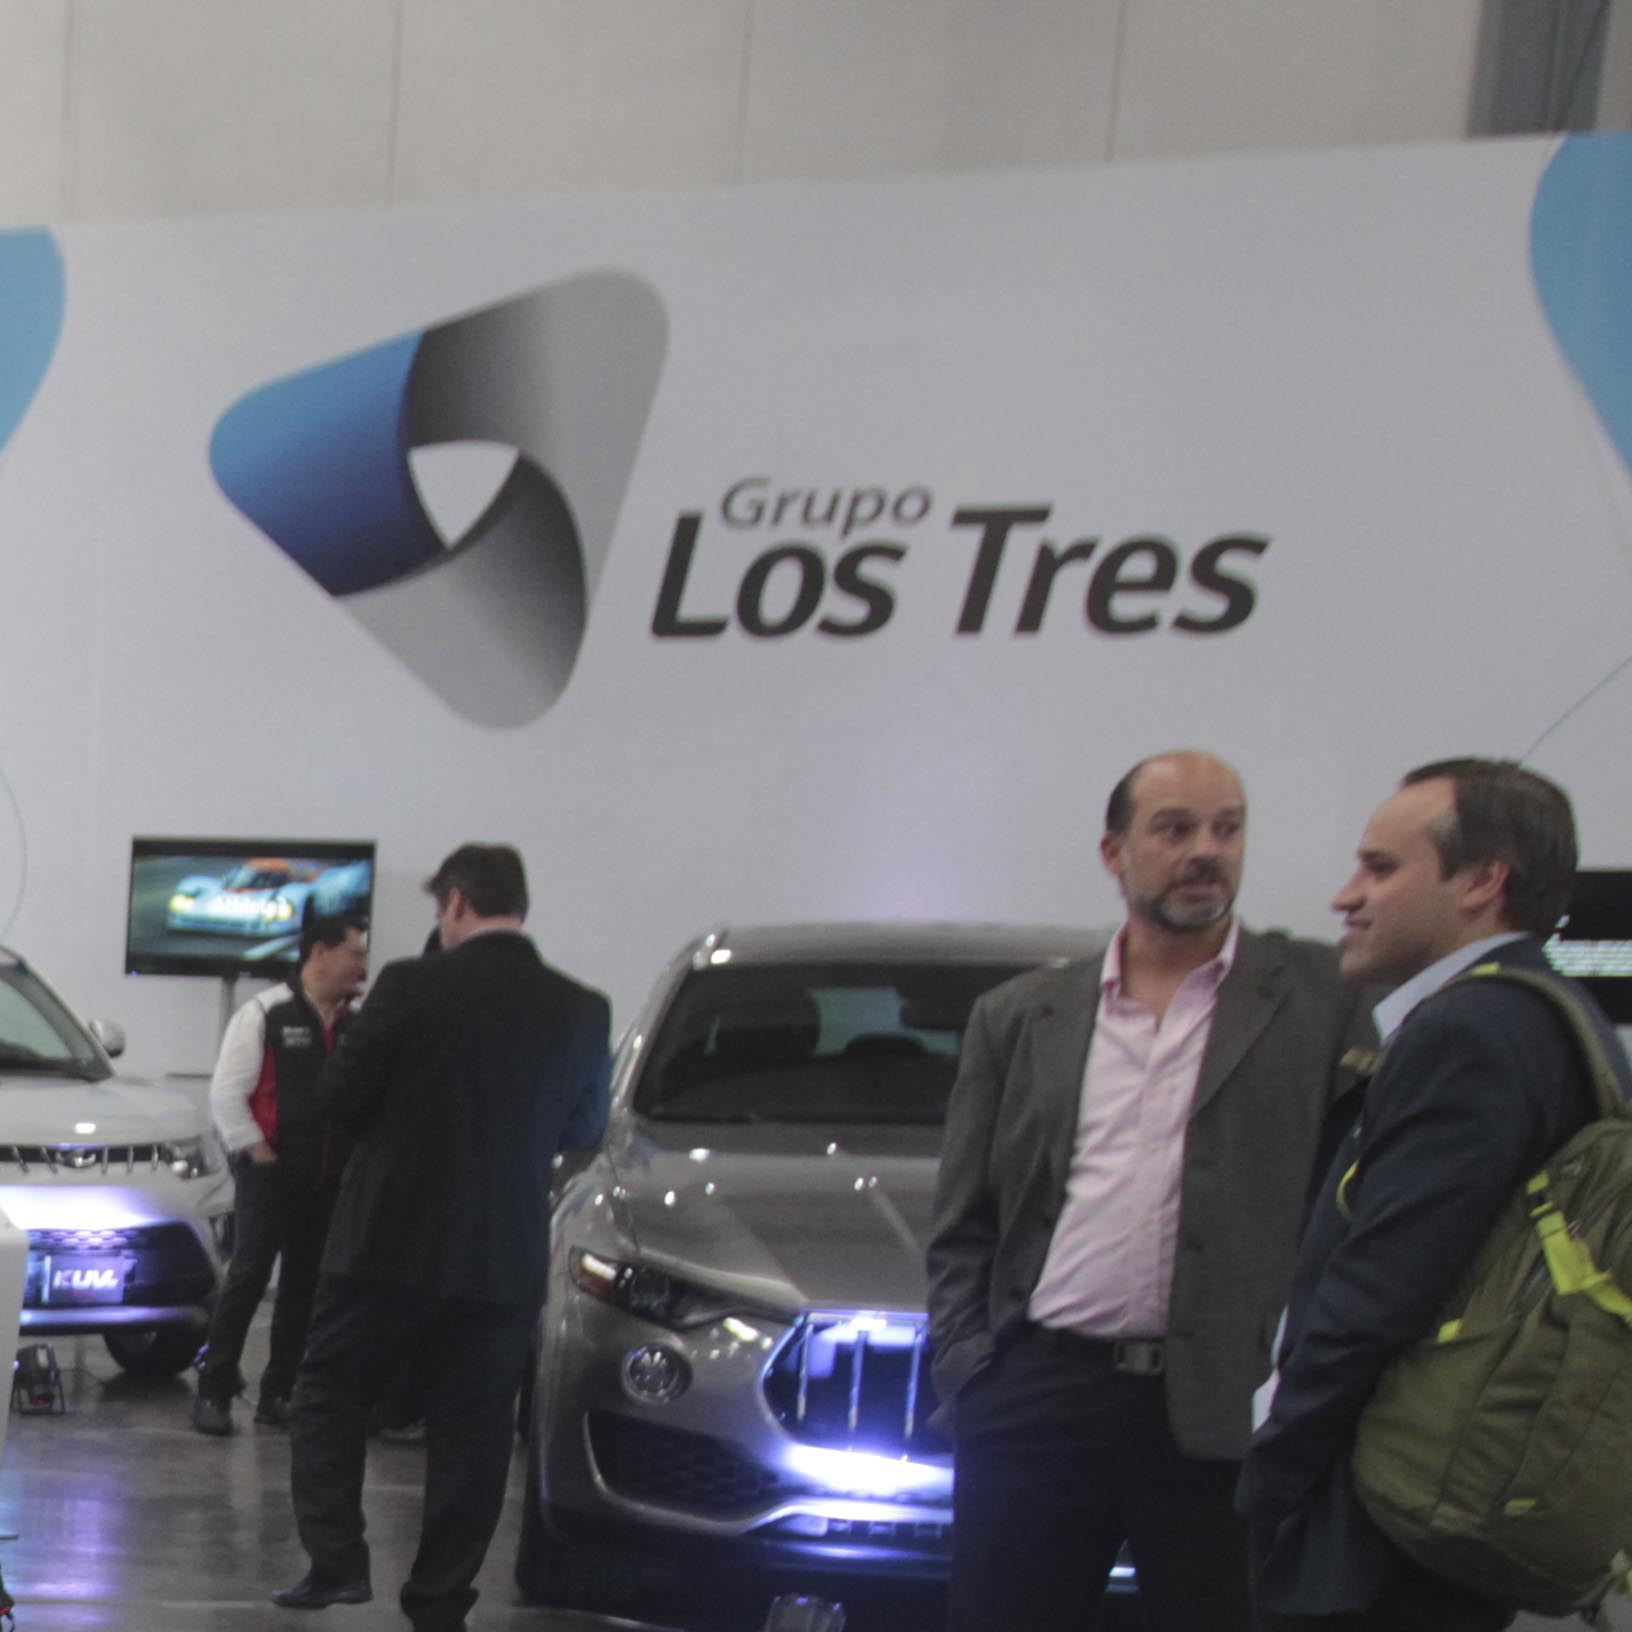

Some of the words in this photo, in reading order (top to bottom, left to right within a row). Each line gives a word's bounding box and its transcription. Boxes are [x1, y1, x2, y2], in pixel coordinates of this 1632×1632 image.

[720, 478, 932, 541] Grupo
[649, 511, 908, 641] Los
[949, 504, 1270, 640] Tres
